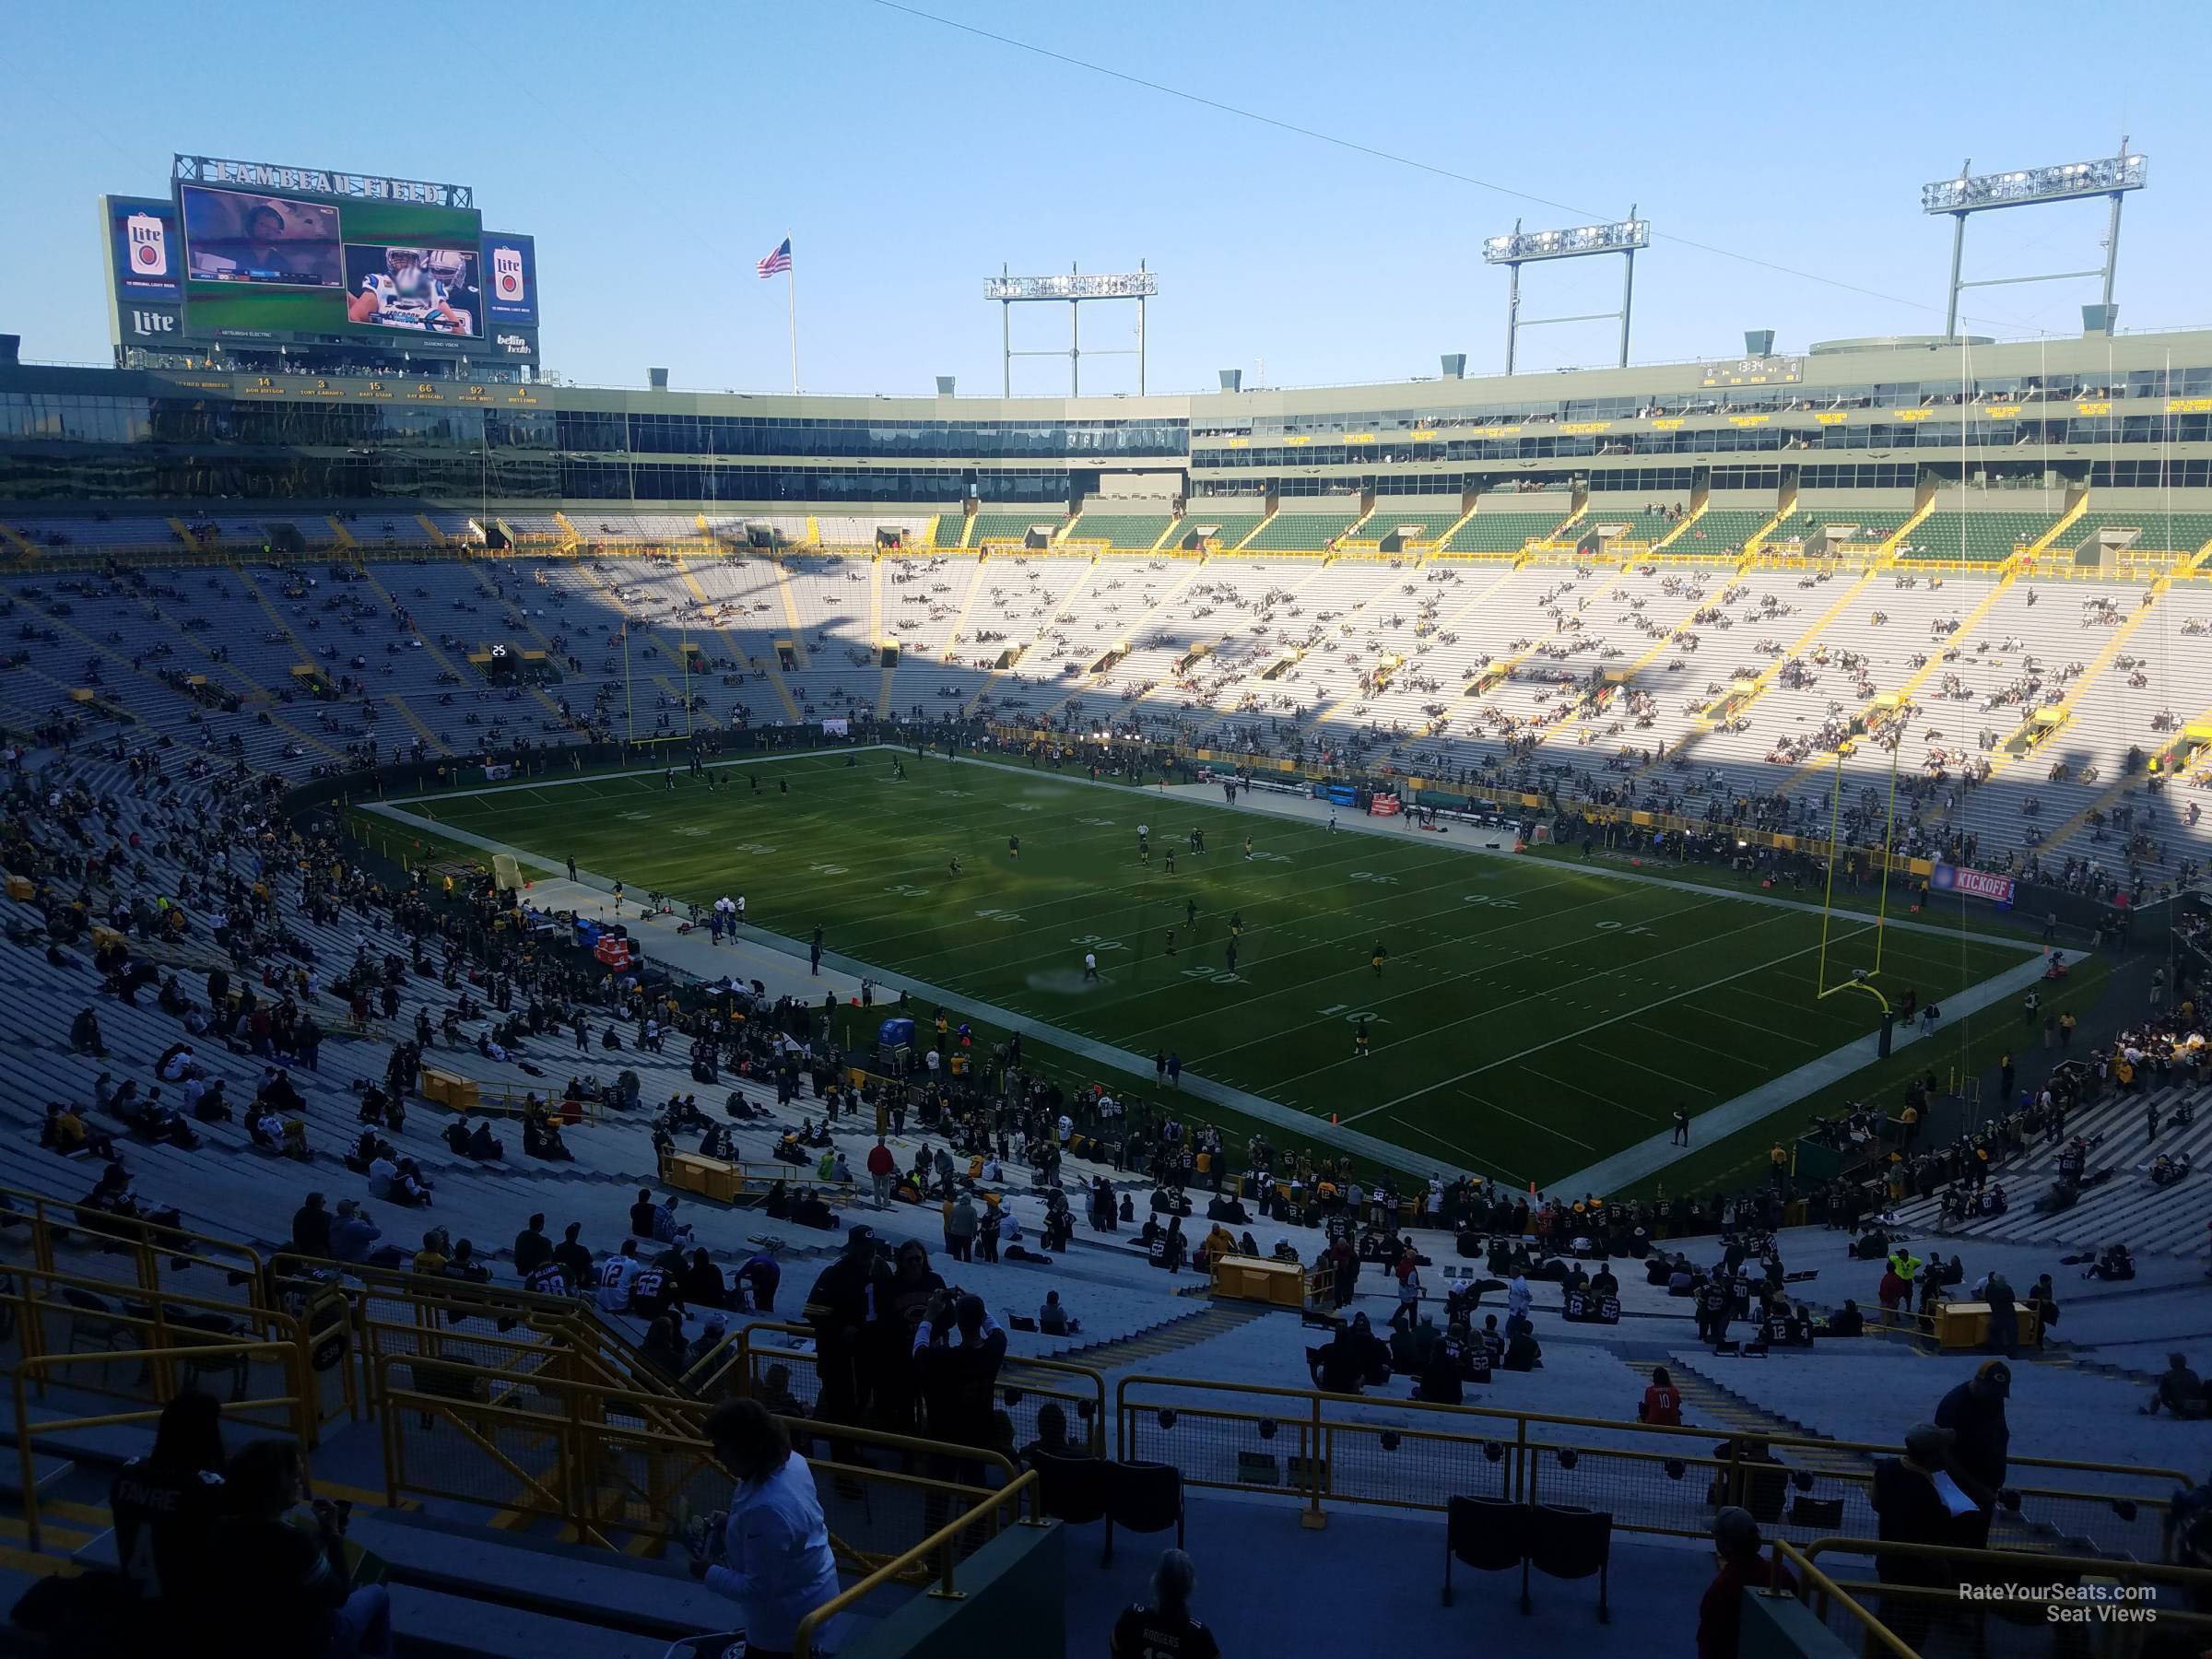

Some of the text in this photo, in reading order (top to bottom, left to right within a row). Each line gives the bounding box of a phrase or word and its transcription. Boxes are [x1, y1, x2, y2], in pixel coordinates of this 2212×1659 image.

[217, 161, 440, 203] LAMBEAU FIELD
[132, 226, 161, 244] Lite
[497, 258, 520, 274] Lite
[132, 310, 174, 336] Lite
[497, 334, 525, 346] bellin
[508, 344, 532, 355] health
[1707, 368, 1712, 377] 0
[1738, 360, 1764, 372] 13:34
[1791, 362, 1796, 371] 0
[257, 377, 270, 386] 14
[318, 379, 325, 388] 3
[369, 382, 381, 391] 15
[418, 383, 432, 393] 66
[470, 385, 483, 394] 92
[518, 387, 525, 396] 4
[1956, 872, 2008, 896] KICKOFF
[1069, 935, 1124, 950] 30
[1315, 1004, 1378, 1024] 10
[1373, 1191, 1383, 1202] 52
[1333, 1224, 1346, 1236] 52
[601, 1264, 624, 1288] 12
[1569, 1299, 1583, 1316] 12
[1601, 1303, 1619, 1318] 52
[1771, 1325, 1787, 1340] 12
[1800, 1327, 1808, 1340] 4
[1472, 1356, 1489, 1371] 52
[1659, 1393, 1670, 1409] 10
[117, 1478, 183, 1512] FAVRE
[1142, 1628, 1181, 1649] RODGERS
